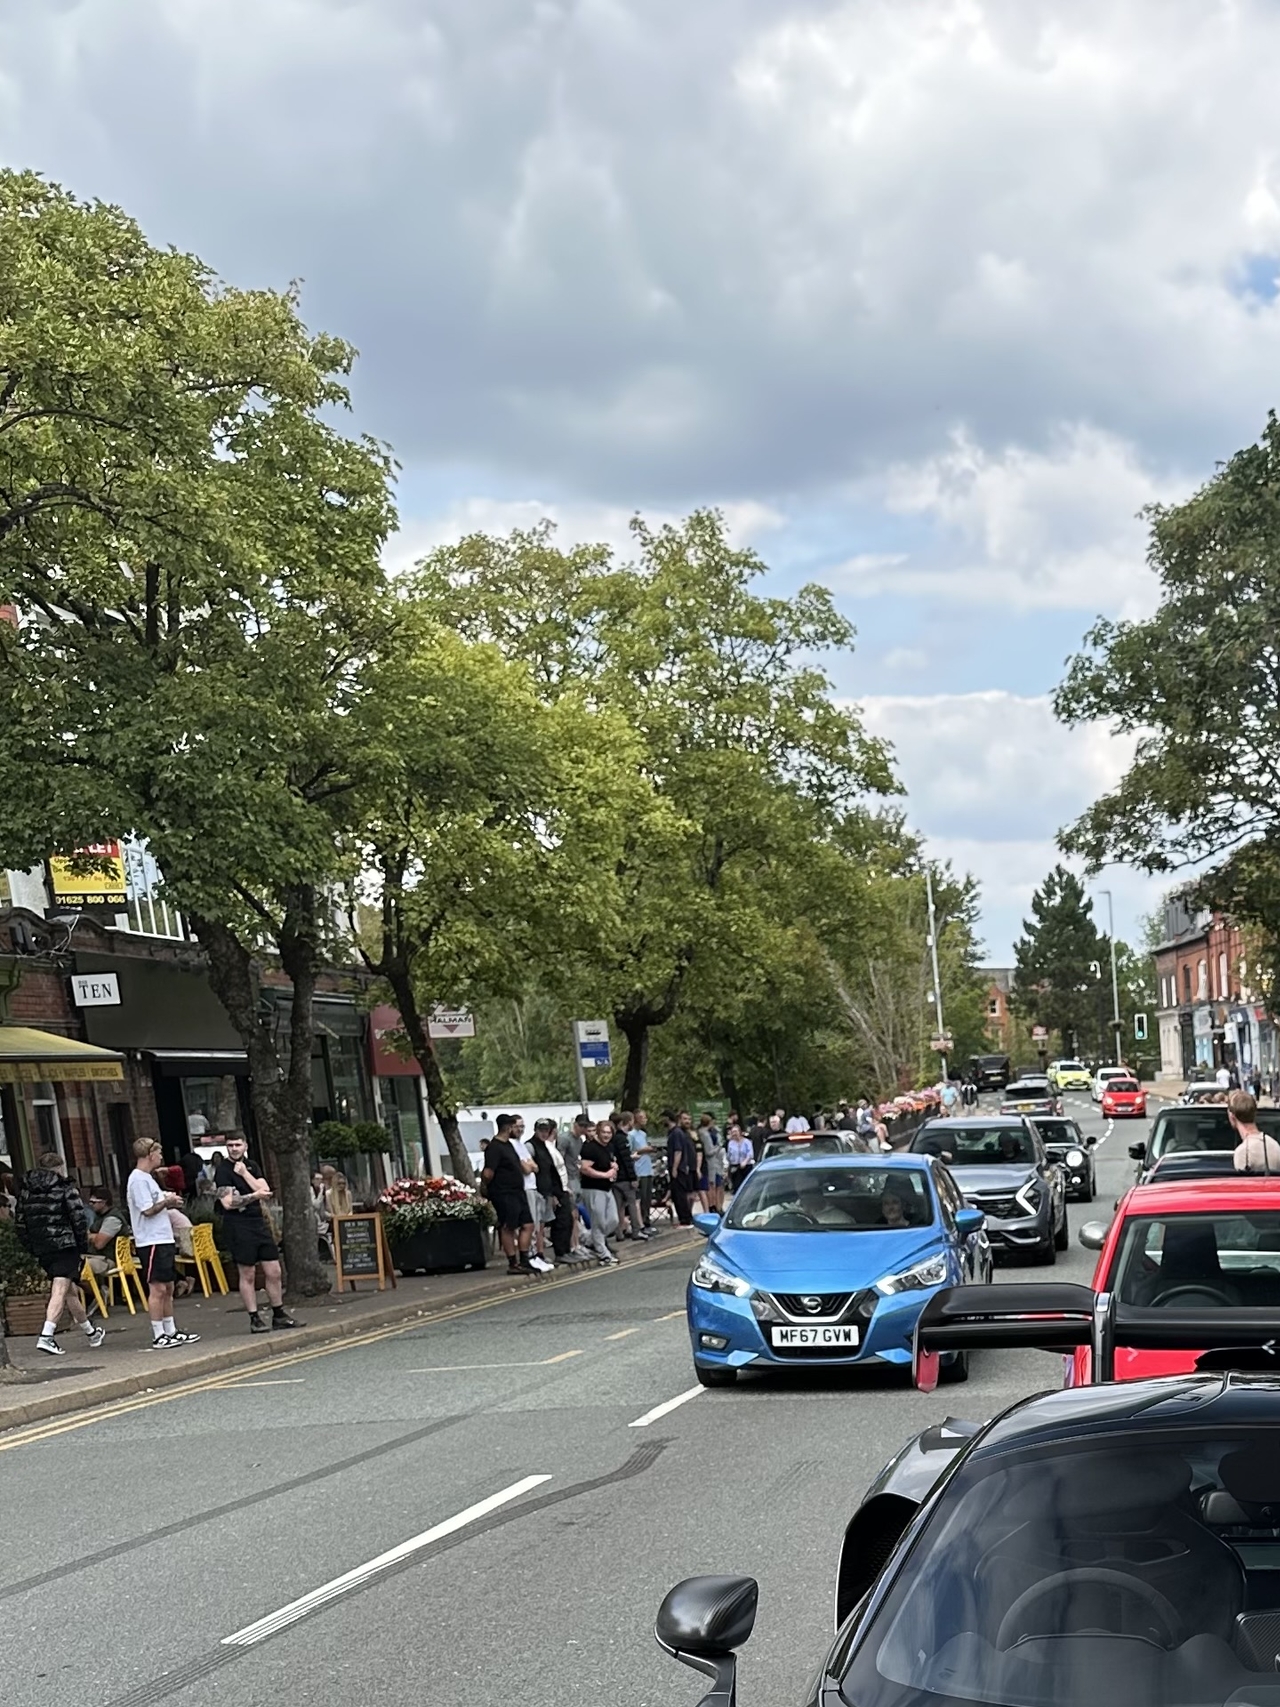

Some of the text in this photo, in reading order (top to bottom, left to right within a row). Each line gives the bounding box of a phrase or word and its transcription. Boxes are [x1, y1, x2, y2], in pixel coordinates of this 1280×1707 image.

[56, 895, 125, 905] 01625 800 066
[79, 983, 113, 999] TEN
[780, 1328, 852, 1342] MF67 GVW
